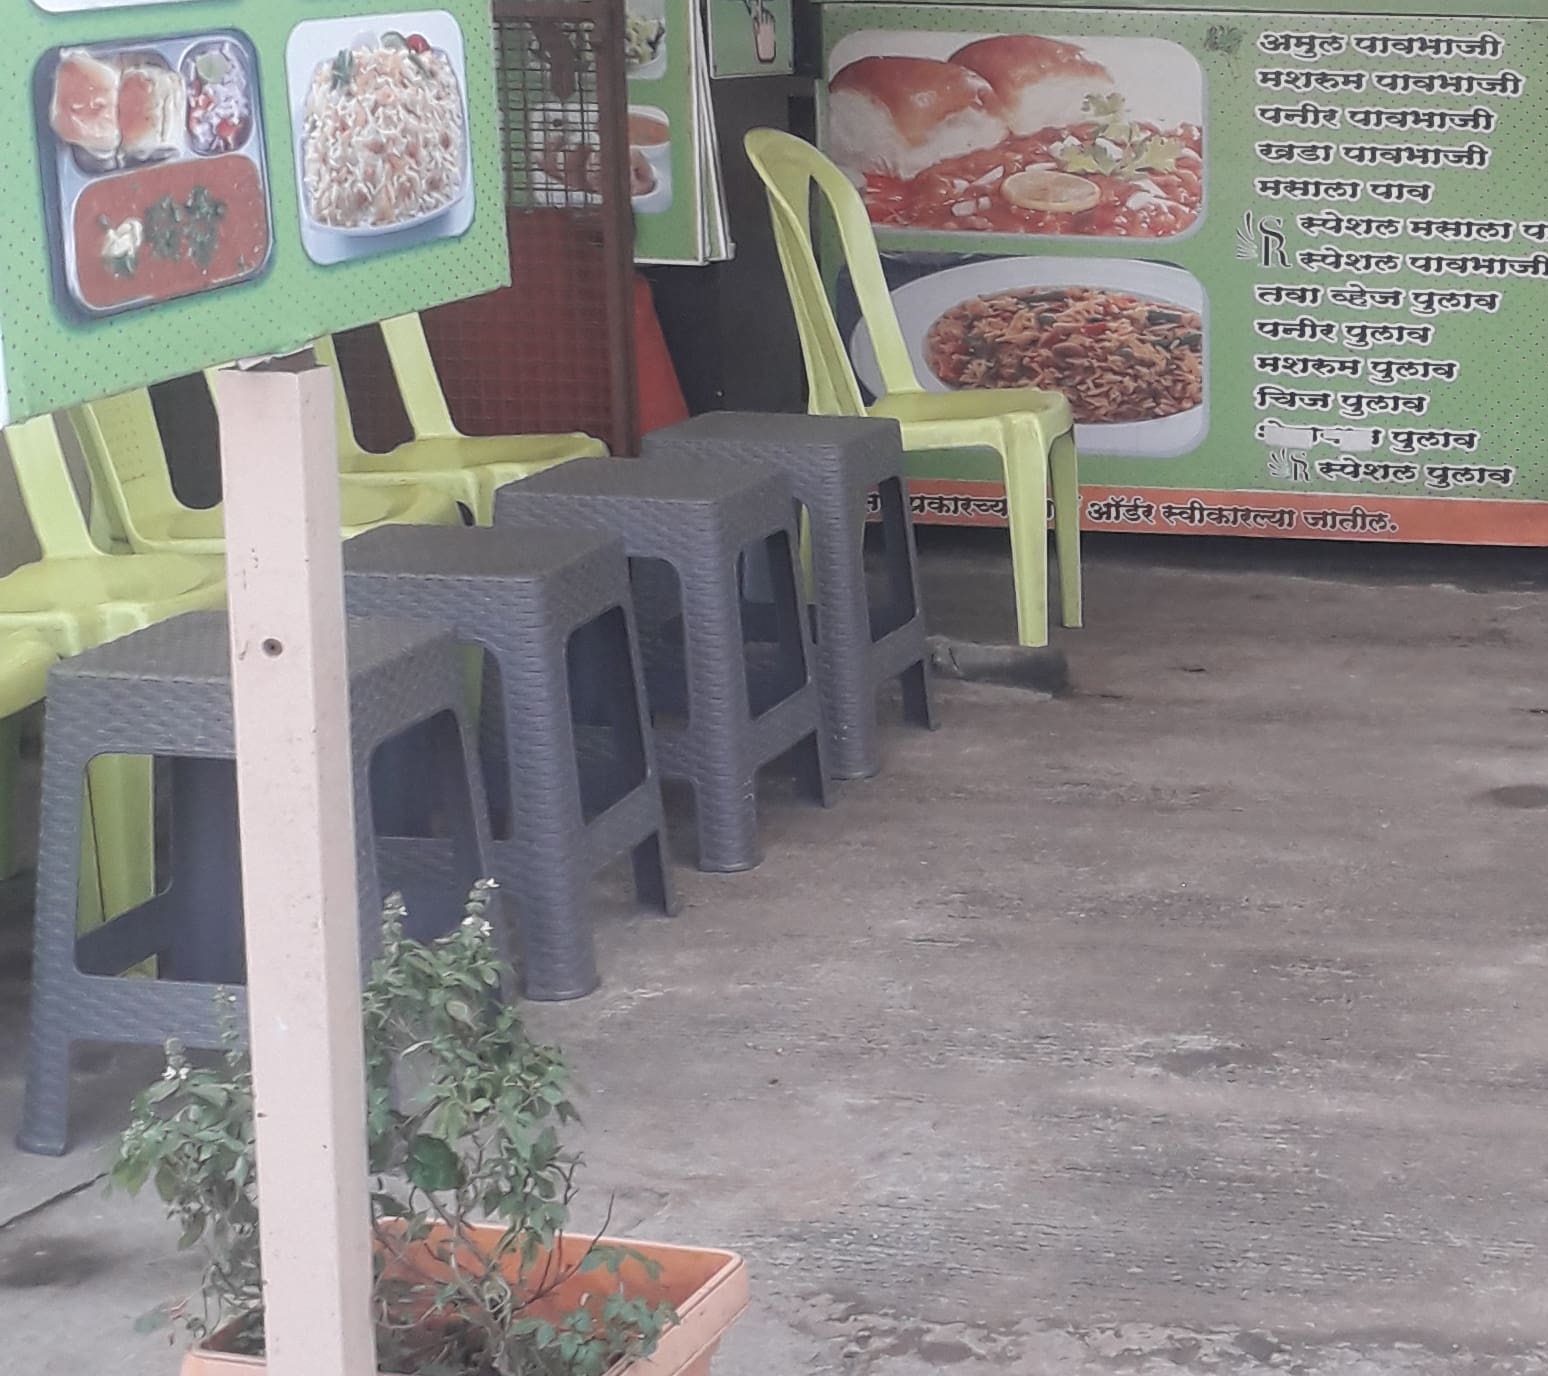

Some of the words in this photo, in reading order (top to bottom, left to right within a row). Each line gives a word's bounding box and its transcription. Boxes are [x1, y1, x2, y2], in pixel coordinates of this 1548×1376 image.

[1260, 34, 1344, 58] अमुल
[1355, 35, 1501, 56] पावभाजी
[1375, 72, 1521, 95] पावभाजी
[1258, 104, 1338, 127] पनीर
[1349, 108, 1494, 131] पावभाजी
[1258, 143, 1333, 162] खडा
[1343, 145, 1488, 167] पावभाजी
[1258, 180, 1360, 199] मसाला
[1371, 183, 1431, 202] पाव
[1300, 212, 1401, 236] स्पेशल
[1410, 221, 1511, 240] मसाला
[1300, 248, 1401, 273] स्पेशल
[1256, 286, 1320, 305] तवा
[1331, 283, 1403, 308] व्हेज
[1413, 291, 1499, 314] पुलाव
[1257, 319, 1336, 342] पनीर
[1346, 325, 1432, 348] पुलाव
[1371, 361, 1457, 383] पुलाव
[1257, 386, 1331, 408] चिज
[1341, 394, 1427, 417] पुलाव
[1392, 430, 1477, 453] पुलाव
[1319, 457, 1417, 482] स्पेशल
[1427, 466, 1512, 489] पुलाव
[1088, 498, 1155, 523] ऑर्डर
[1161, 499, 1296, 528] स्वीकारल्या
[1303, 508, 1398, 532] जातील.
